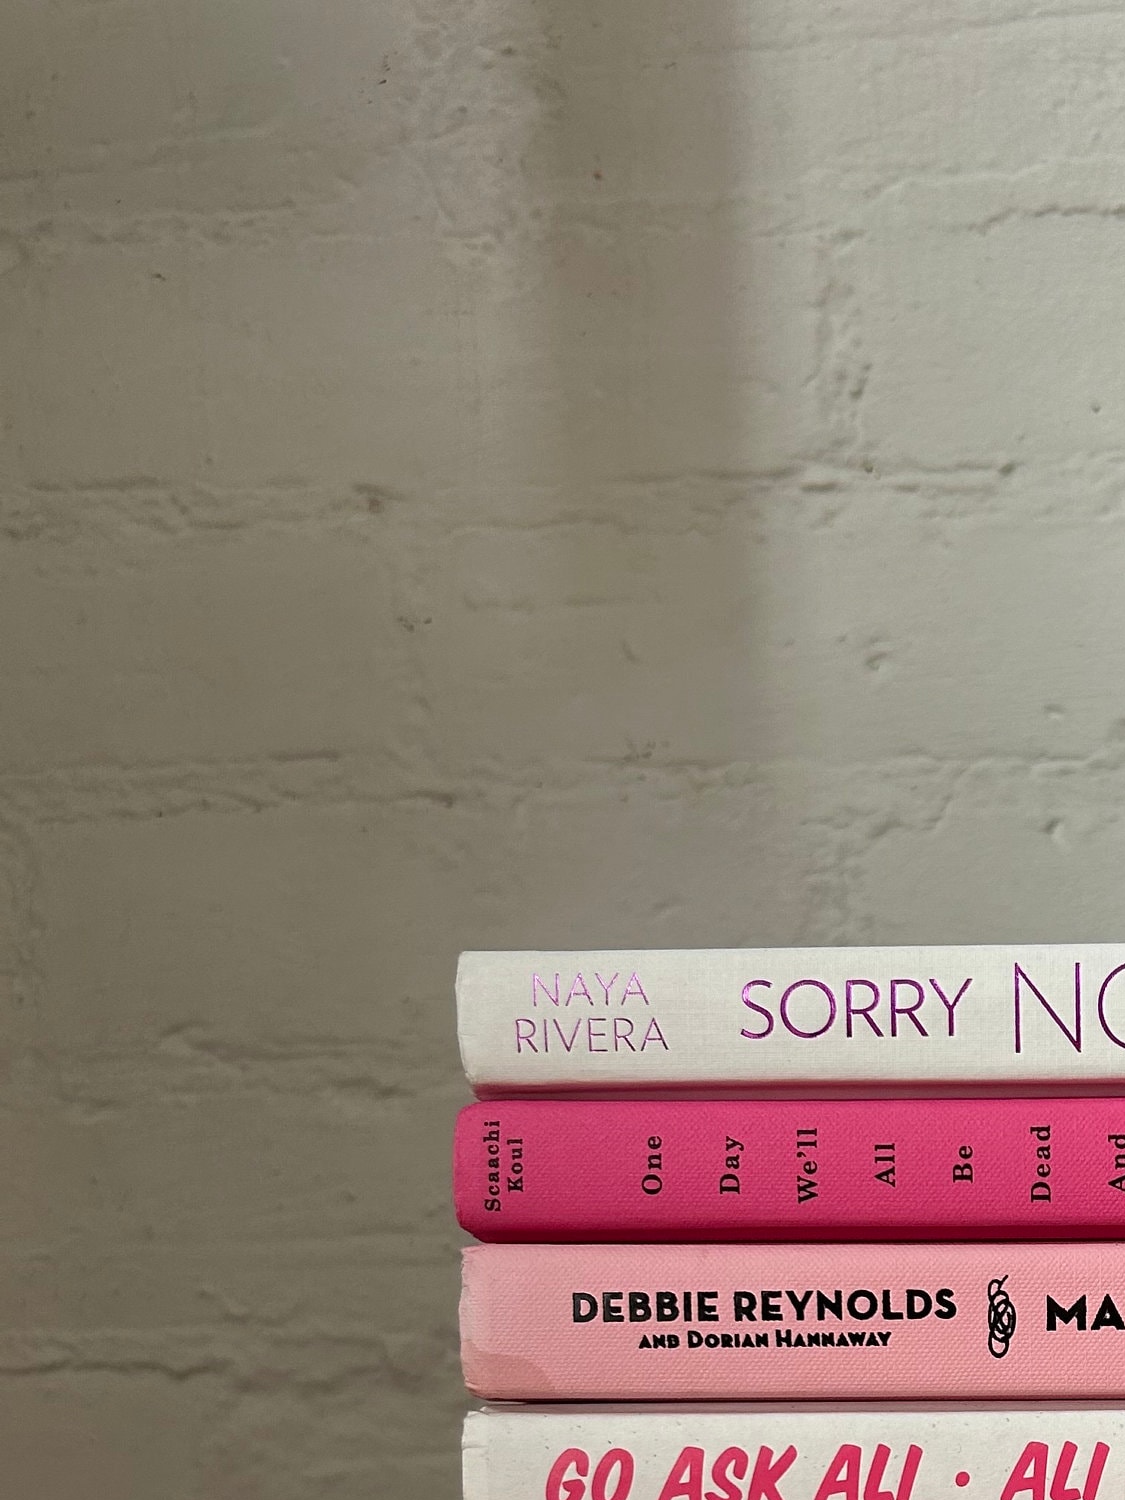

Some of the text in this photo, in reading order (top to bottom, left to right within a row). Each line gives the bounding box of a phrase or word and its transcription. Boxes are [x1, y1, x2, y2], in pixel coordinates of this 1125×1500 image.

[533, 973, 649, 1006] NAYA
[741, 979, 972, 1039] SORRY
[516, 1018, 668, 1053] RIVERA
[483, 1121, 501, 1211] Scaachi
[507, 1139, 523, 1192] Koul
[642, 1136, 662, 1195] One
[720, 1136, 744, 1194] Day
[797, 1128, 818, 1204] We'll
[874, 1143, 895, 1187] All
[953, 1146, 973, 1183] Be
[1030, 1126, 1051, 1202] Dead
[573, 1289, 956, 1322] DEBBIE REYNOLDS
[776, 1329, 891, 1347] HANNAWAY
